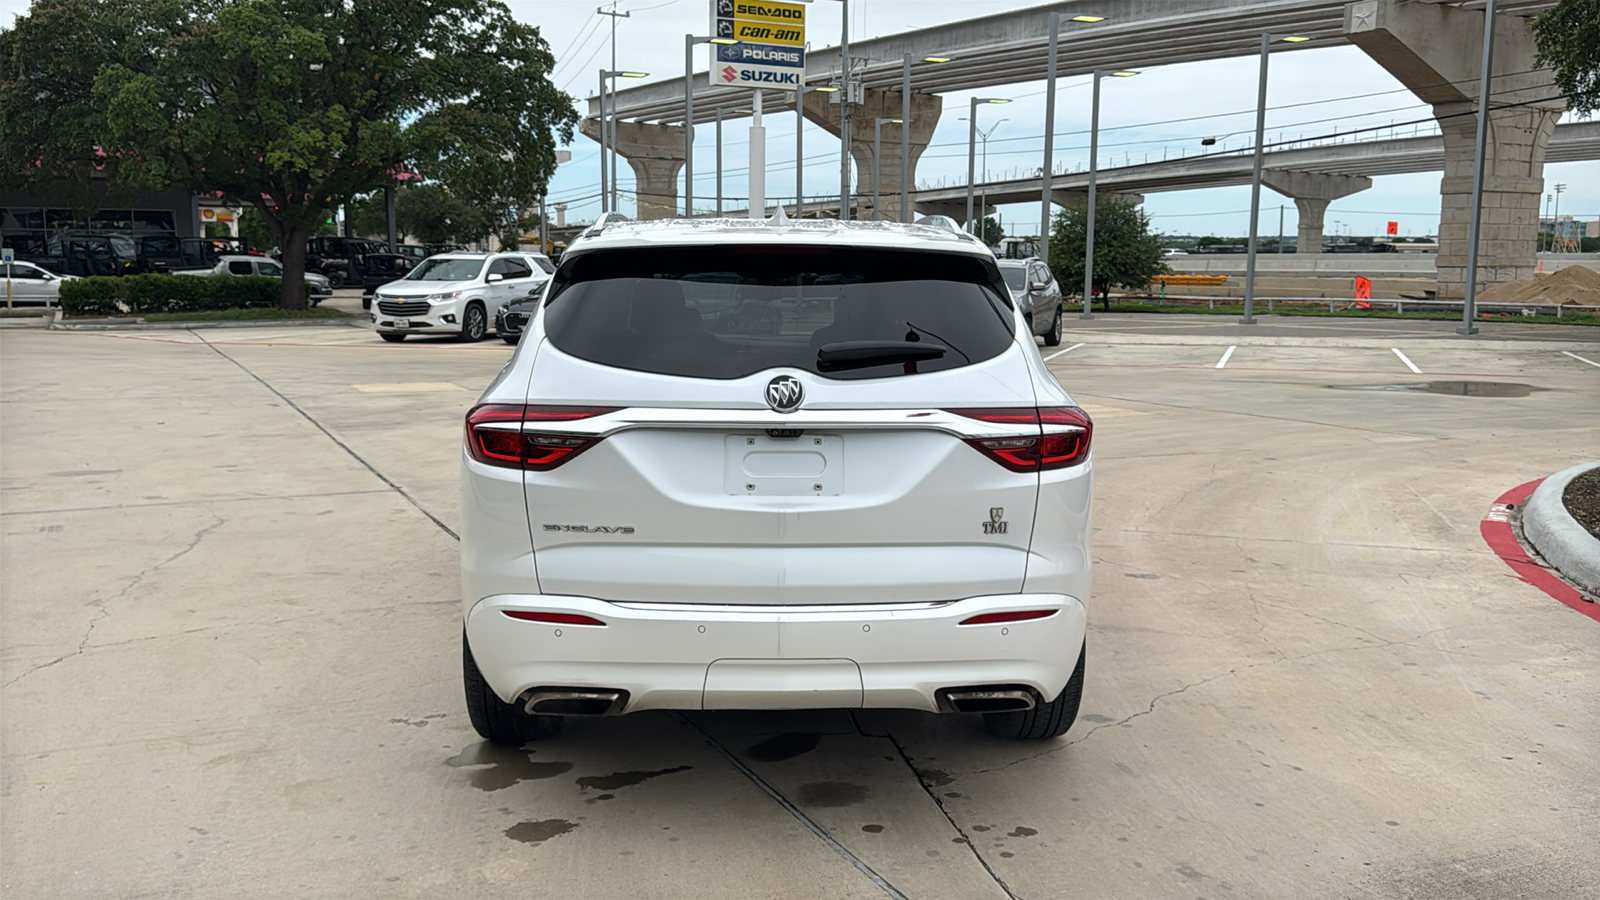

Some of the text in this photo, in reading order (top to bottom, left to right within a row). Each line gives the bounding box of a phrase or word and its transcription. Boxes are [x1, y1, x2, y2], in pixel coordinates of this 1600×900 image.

[743, 49, 799, 62] POLARIS
[740, 69, 800, 84] SUZUKI
[542, 524, 635, 533] ENCLAVE
[982, 521, 1009, 534] TMI
